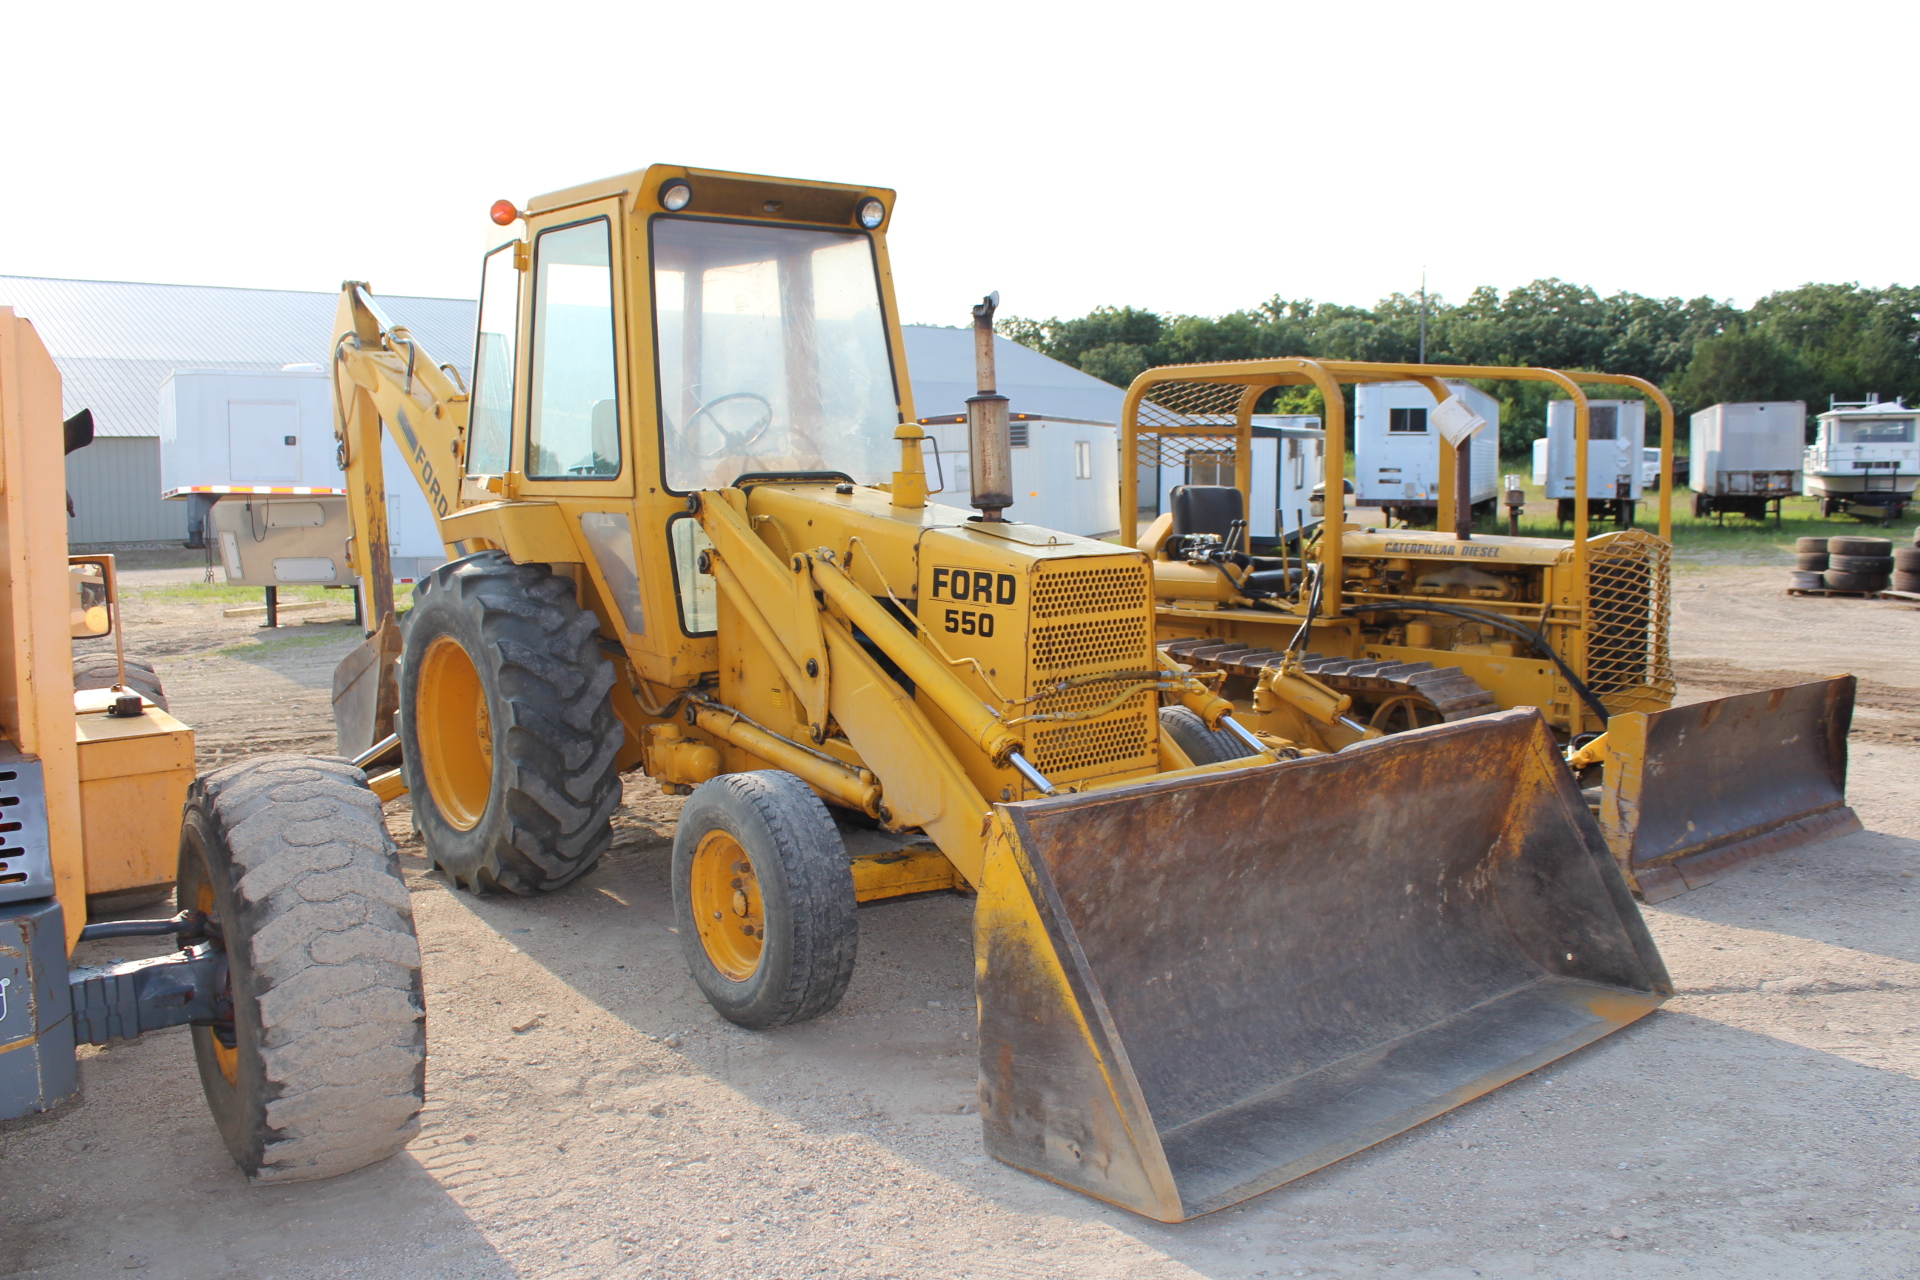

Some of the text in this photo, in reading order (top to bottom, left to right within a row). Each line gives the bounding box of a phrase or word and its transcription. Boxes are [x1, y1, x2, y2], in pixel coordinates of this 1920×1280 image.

[414, 445, 448, 518] FORD
[1385, 542, 1500, 558] CATERPILLAR DIESEL
[932, 568, 1016, 605] FORD
[945, 609, 994, 638] 550
